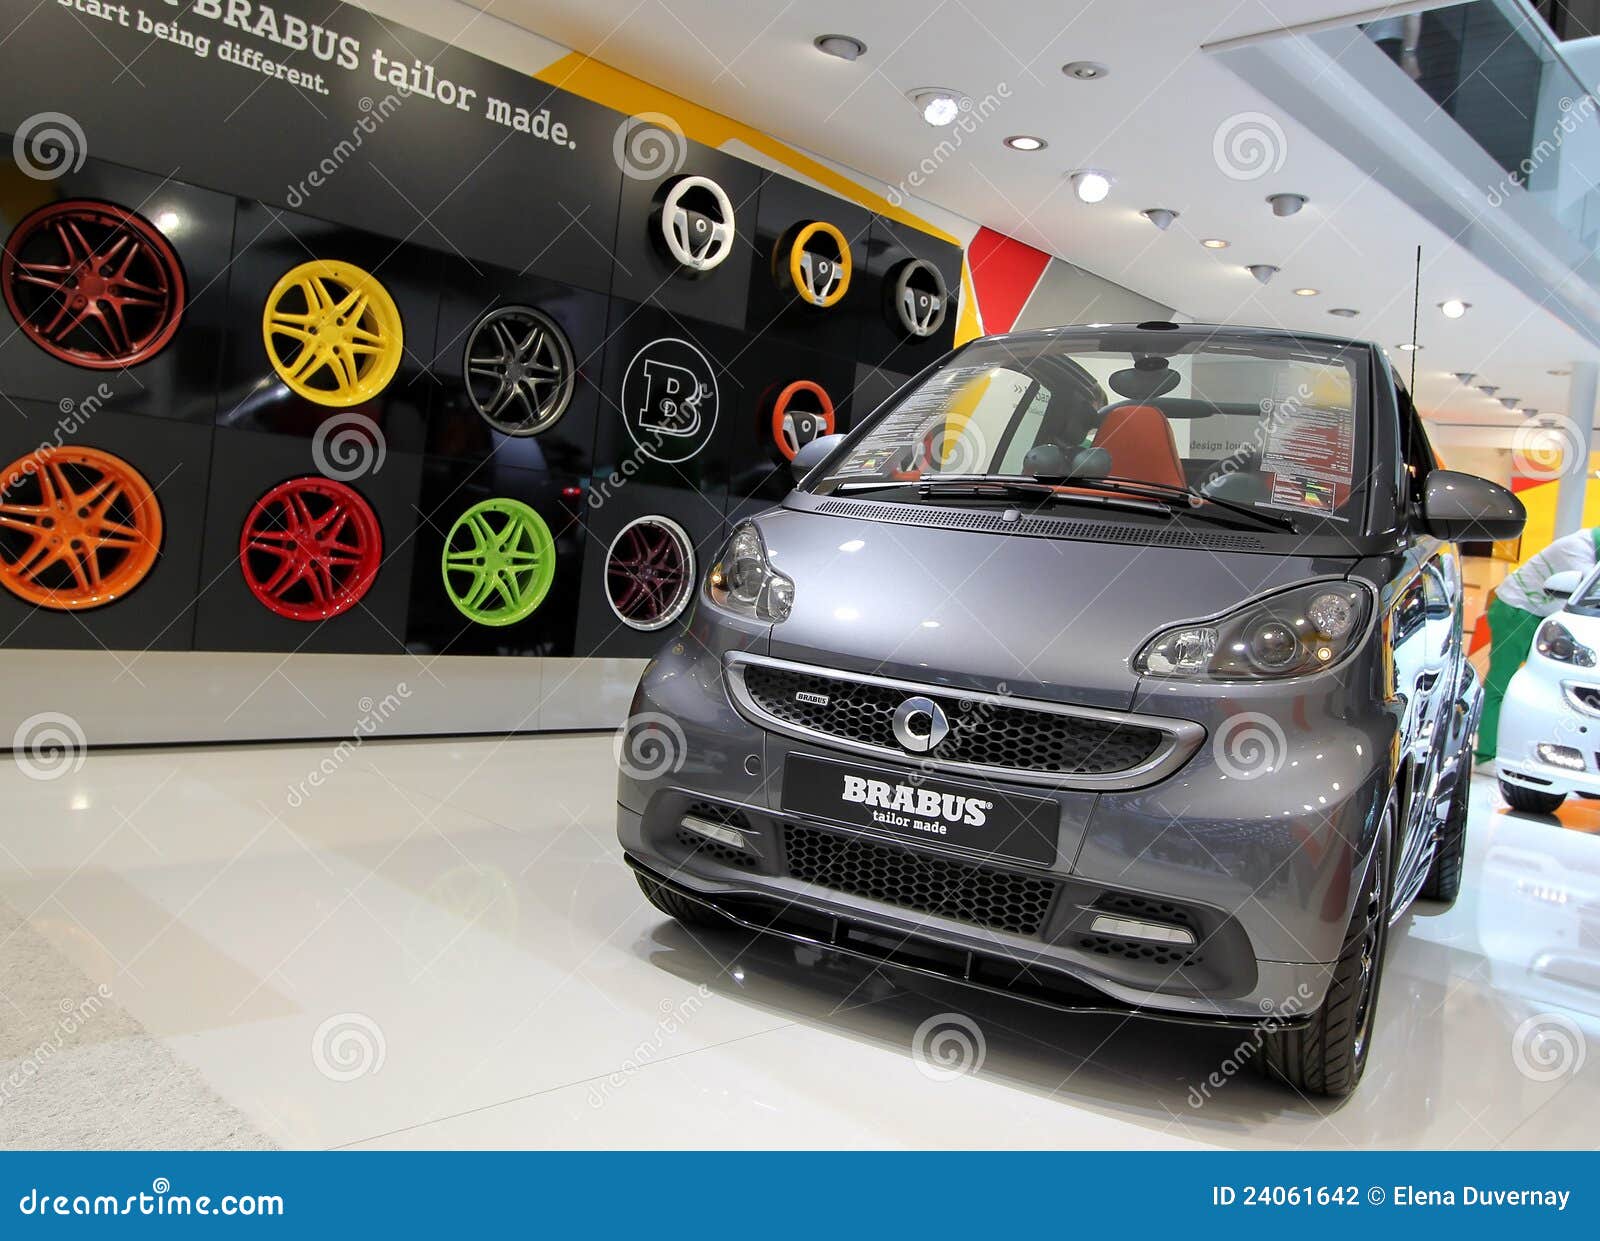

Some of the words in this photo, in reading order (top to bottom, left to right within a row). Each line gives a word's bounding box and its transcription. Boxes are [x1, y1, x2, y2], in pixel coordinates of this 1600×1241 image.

[137, 10, 211, 57] being
[217, 41, 330, 95] different.
[372, 48, 477, 111] tailor
[486, 96, 577, 150] made.
[797, 693, 828, 705] BRABUS
[872, 810, 911, 827] tailor
[912, 819, 947, 835] made
